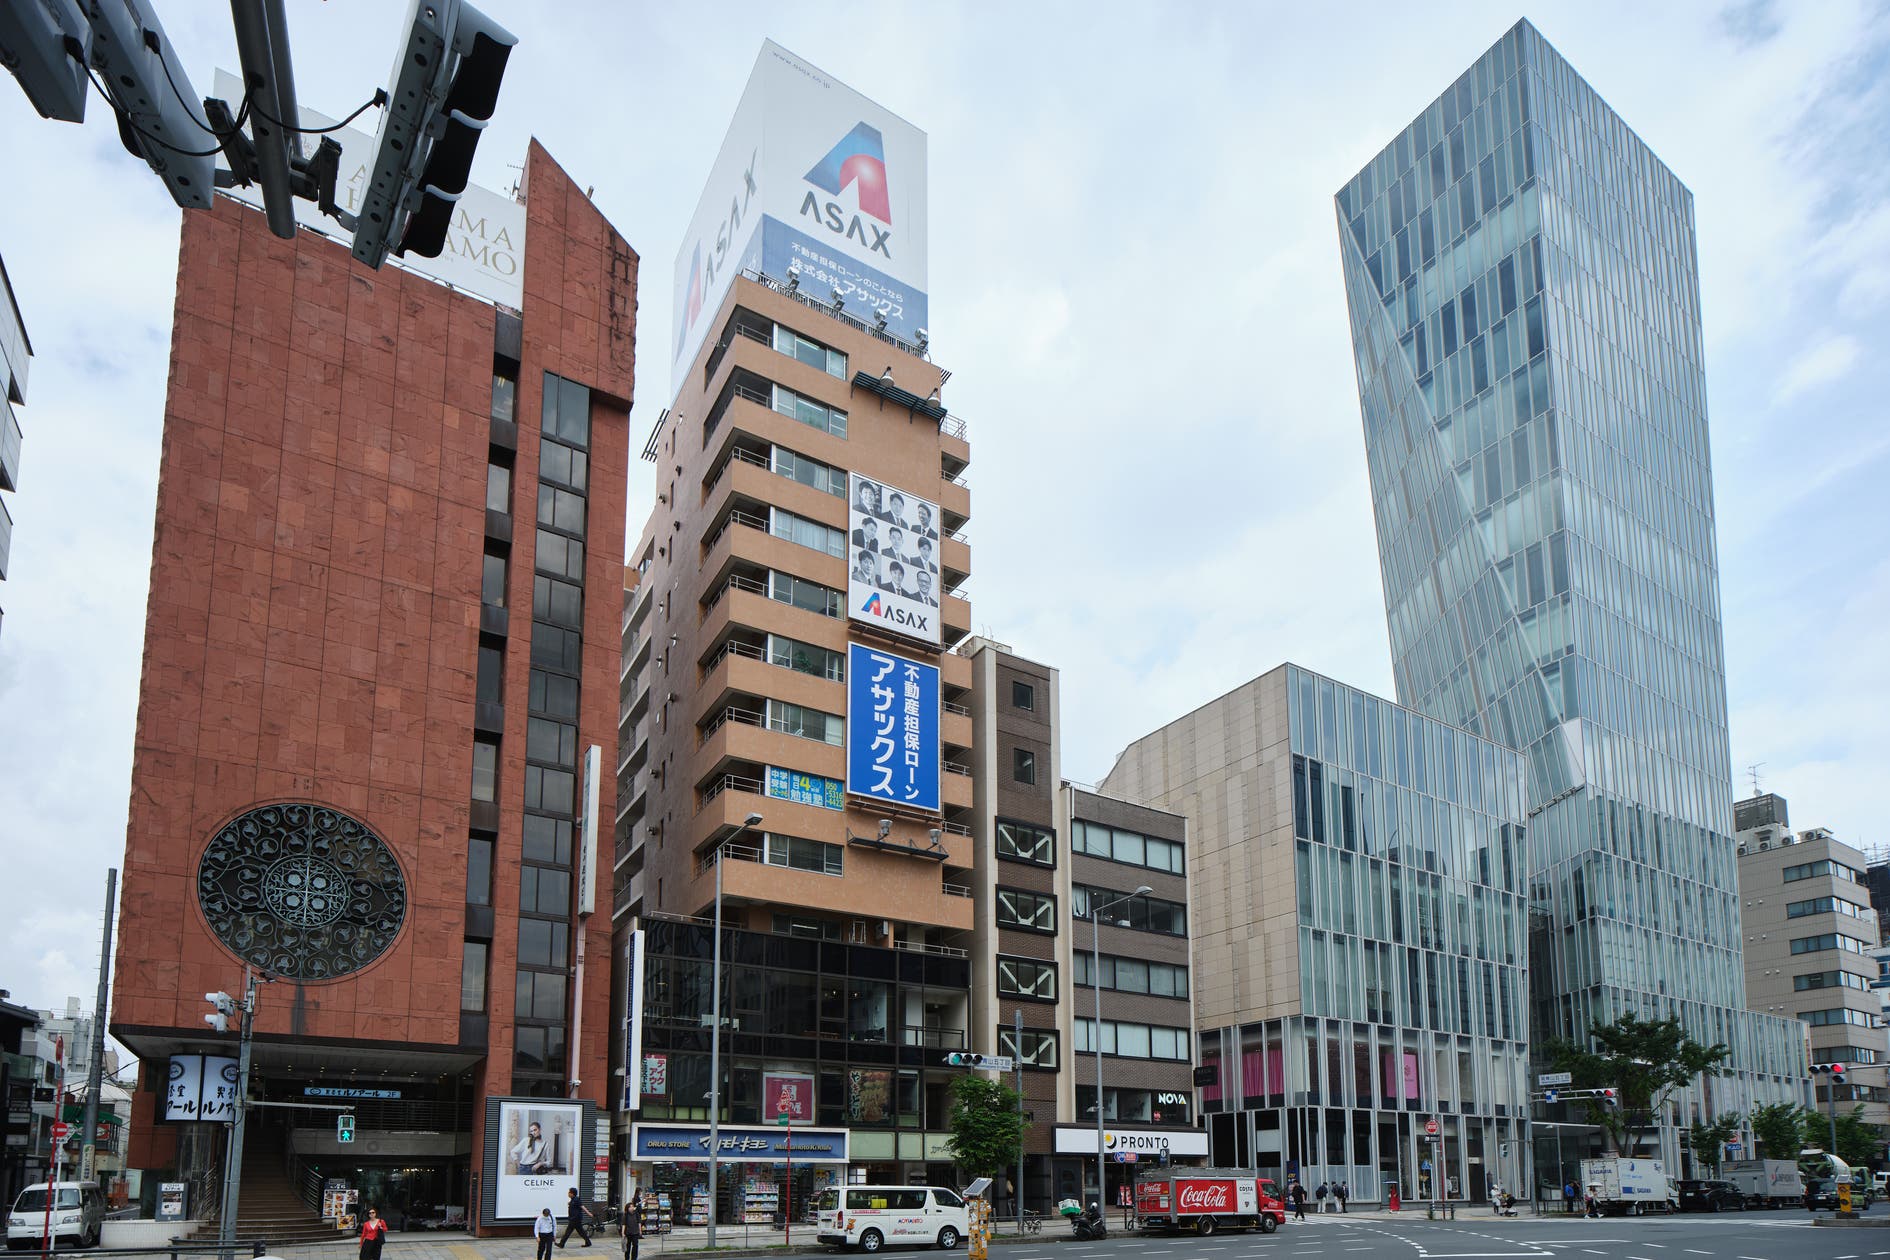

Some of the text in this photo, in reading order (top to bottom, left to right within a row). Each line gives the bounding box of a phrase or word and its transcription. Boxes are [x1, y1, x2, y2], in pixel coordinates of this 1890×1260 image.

[800, 190, 891, 260] ASAX
[791, 241, 904, 303] 不動産担保ローンのことなら
[790, 256, 904, 321] 株式会社アサックス
[884, 604, 928, 632] ASAX
[870, 653, 895, 796] アサックス
[904, 663, 920, 800] 不動産担保ローン
[1158, 1092, 1187, 1105] NOVA
[647, 1141, 690, 1149] DRUG STORE
[1121, 1136, 1169, 1149] PRONTO
[524, 1179, 555, 1187] CELINE
[1180, 1185, 1227, 1208] Coca-Cola
